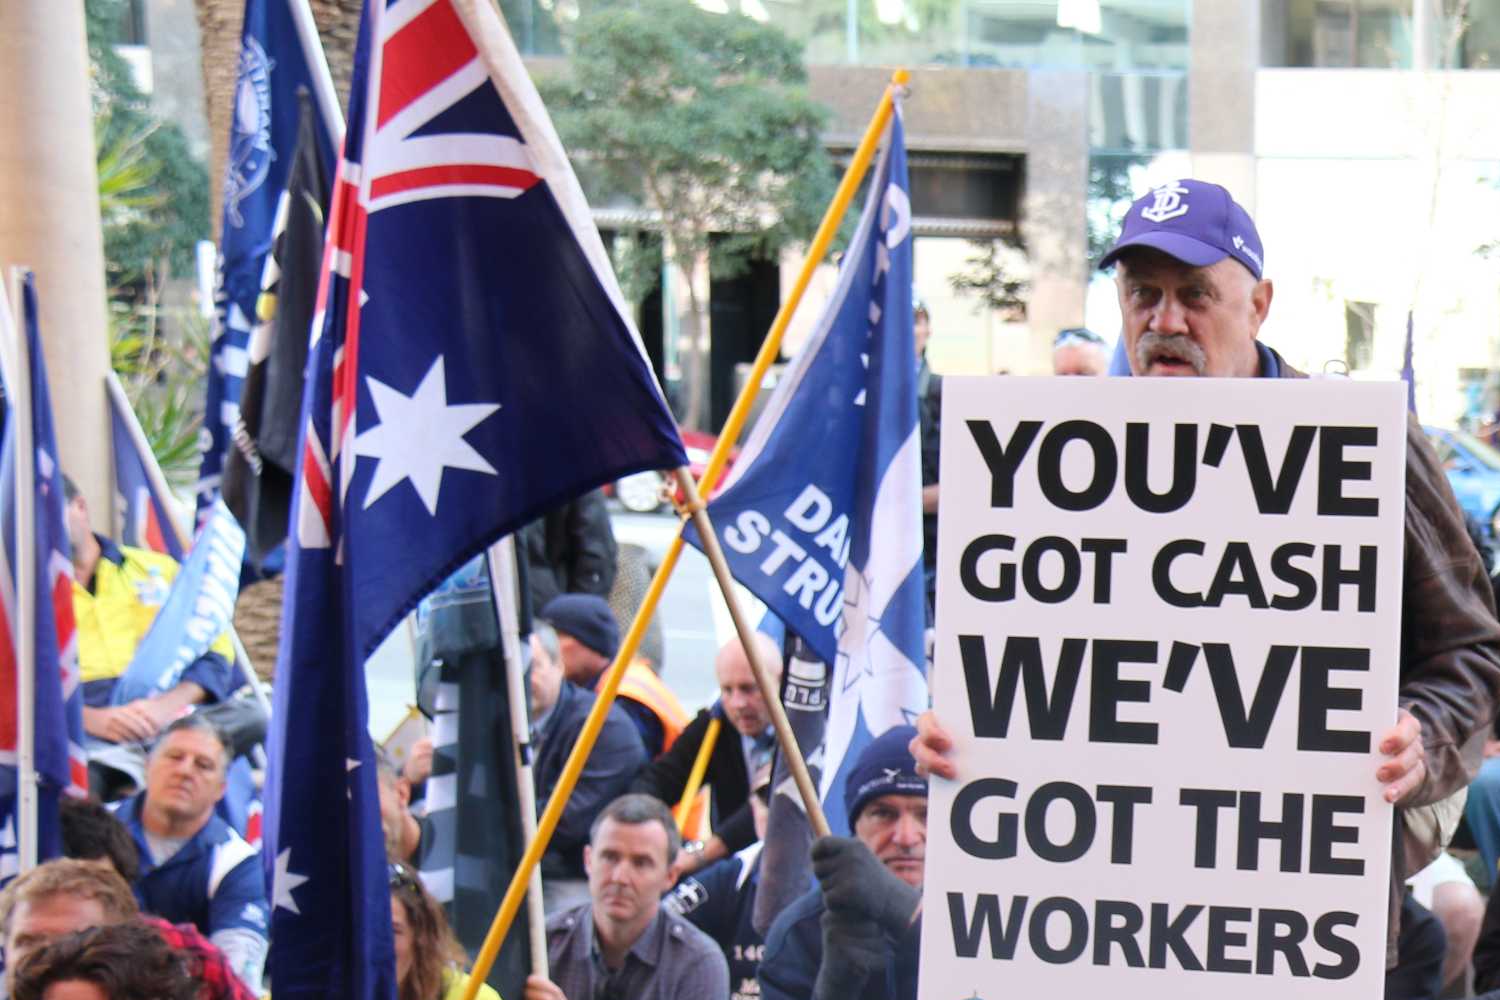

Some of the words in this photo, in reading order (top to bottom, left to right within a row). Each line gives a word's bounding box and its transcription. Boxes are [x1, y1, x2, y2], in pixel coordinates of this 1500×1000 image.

[965, 420, 1379, 517] YOU'VE
[724, 510, 849, 642] STRU
[959, 533, 1128, 605] GOT
[1151, 538, 1378, 613] CASH
[957, 634, 1372, 754] WE'VE
[950, 776, 1153, 865] GOT
[1179, 787, 1366, 876] THE
[946, 891, 1361, 980] WORKERS
